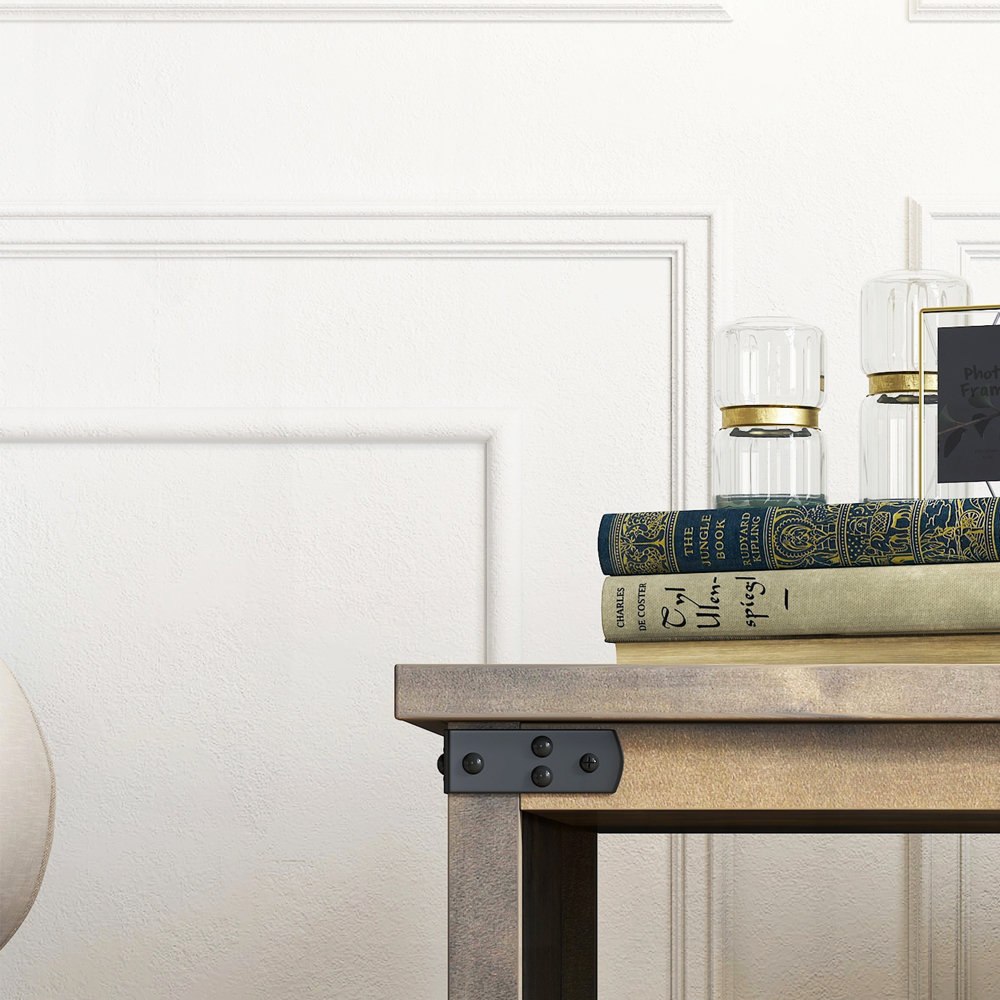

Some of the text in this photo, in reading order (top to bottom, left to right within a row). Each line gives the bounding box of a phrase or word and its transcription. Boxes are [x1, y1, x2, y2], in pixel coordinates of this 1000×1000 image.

[683, 526, 694, 557] THE
[699, 514, 712, 567] JUNGLE
[714, 518, 726, 560] BOOK
[739, 512, 752, 566] RUDYARD
[750, 516, 762, 563] KIPLING
[616, 587, 626, 629] CHARLES
[637, 582, 648, 632] DE COSTER
[661, 587, 700, 630] Tyl
